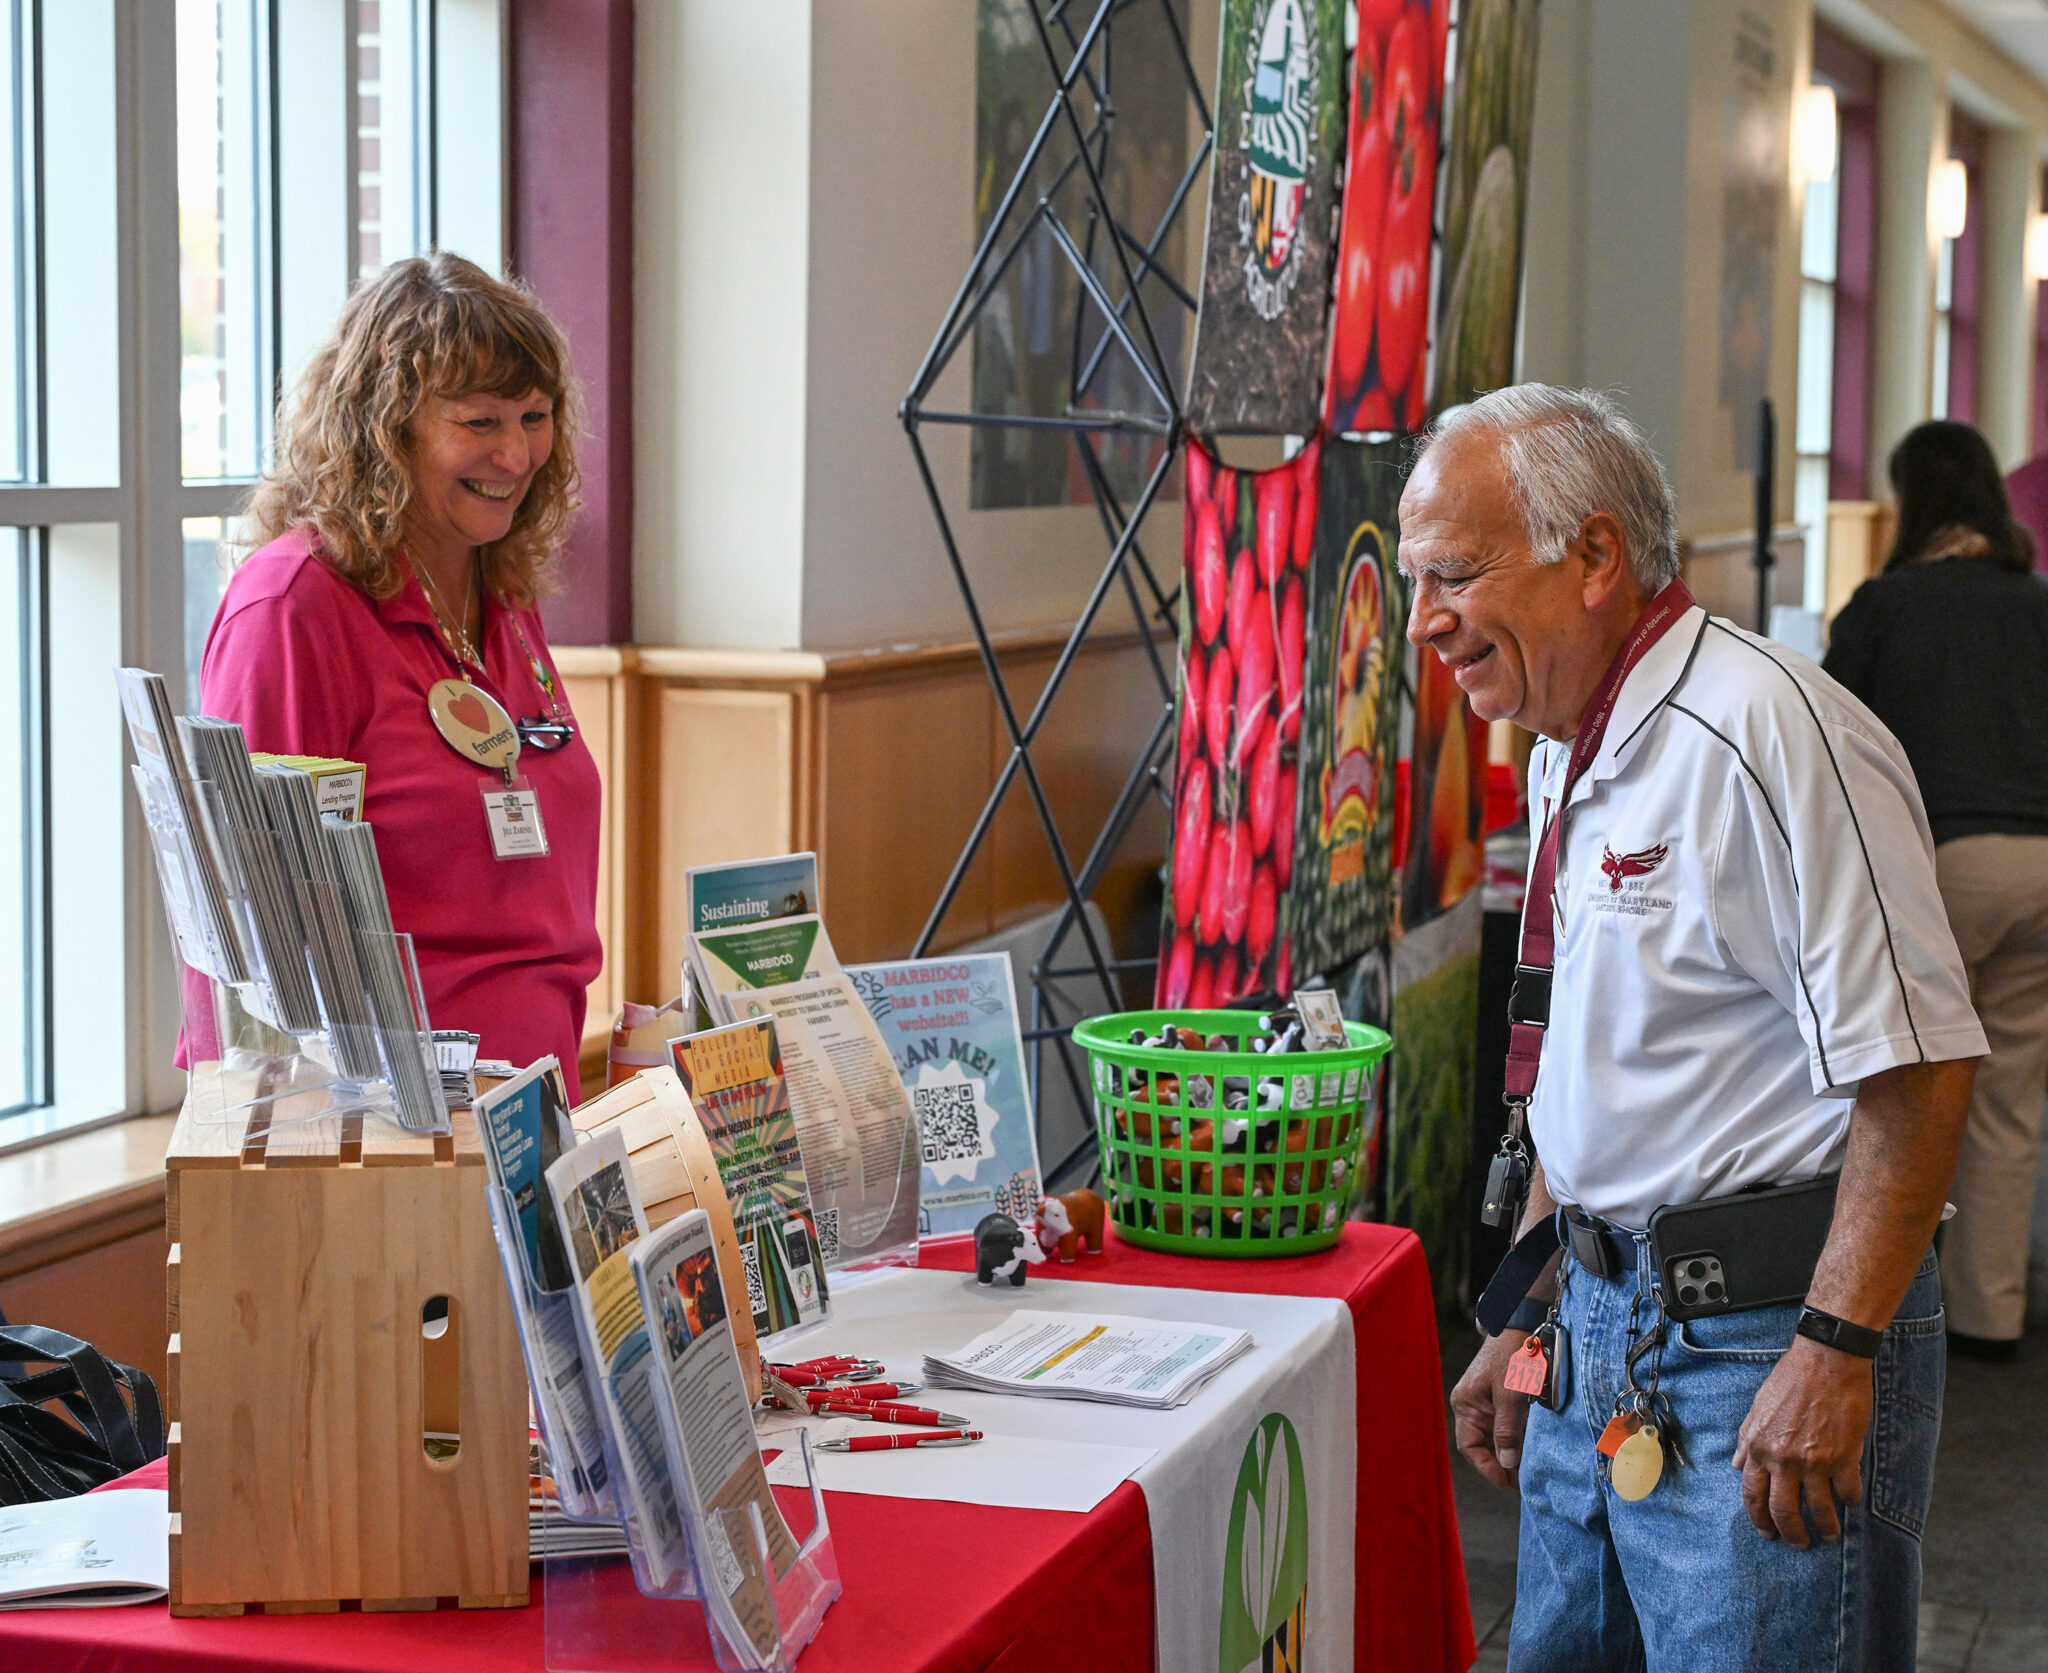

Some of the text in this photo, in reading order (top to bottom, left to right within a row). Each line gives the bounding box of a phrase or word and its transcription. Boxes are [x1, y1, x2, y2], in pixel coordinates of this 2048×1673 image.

[1645, 606, 1671, 630] University
[1640, 627, 1649, 639] of
[445, 685, 457, 697] I
[1591, 711, 1606, 728] 1890
[472, 728, 516, 756] farmers
[1578, 726, 1598, 757] Program
[321, 793, 356, 805] Lending Programs
[701, 898, 770, 922] Sustaining
[1617, 905, 1649, 916] SHORE
[1618, 895, 1673, 910] MARYLAND
[746, 953, 794, 971] MARBIDCO
[883, 965, 970, 988] MARBIDCO
[889, 988, 970, 1010] has a NEW
[897, 1012, 969, 1032] website!!!
[692, 1028, 759, 1055] FOLLOW US
[696, 1046, 761, 1073] ON SOCIAL
[947, 1038, 997, 1078] ME!
[714, 1066, 751, 1084] MEDIA
[691, 1224, 704, 1238] Fund
[1506, 1364, 1544, 1394] 2179
